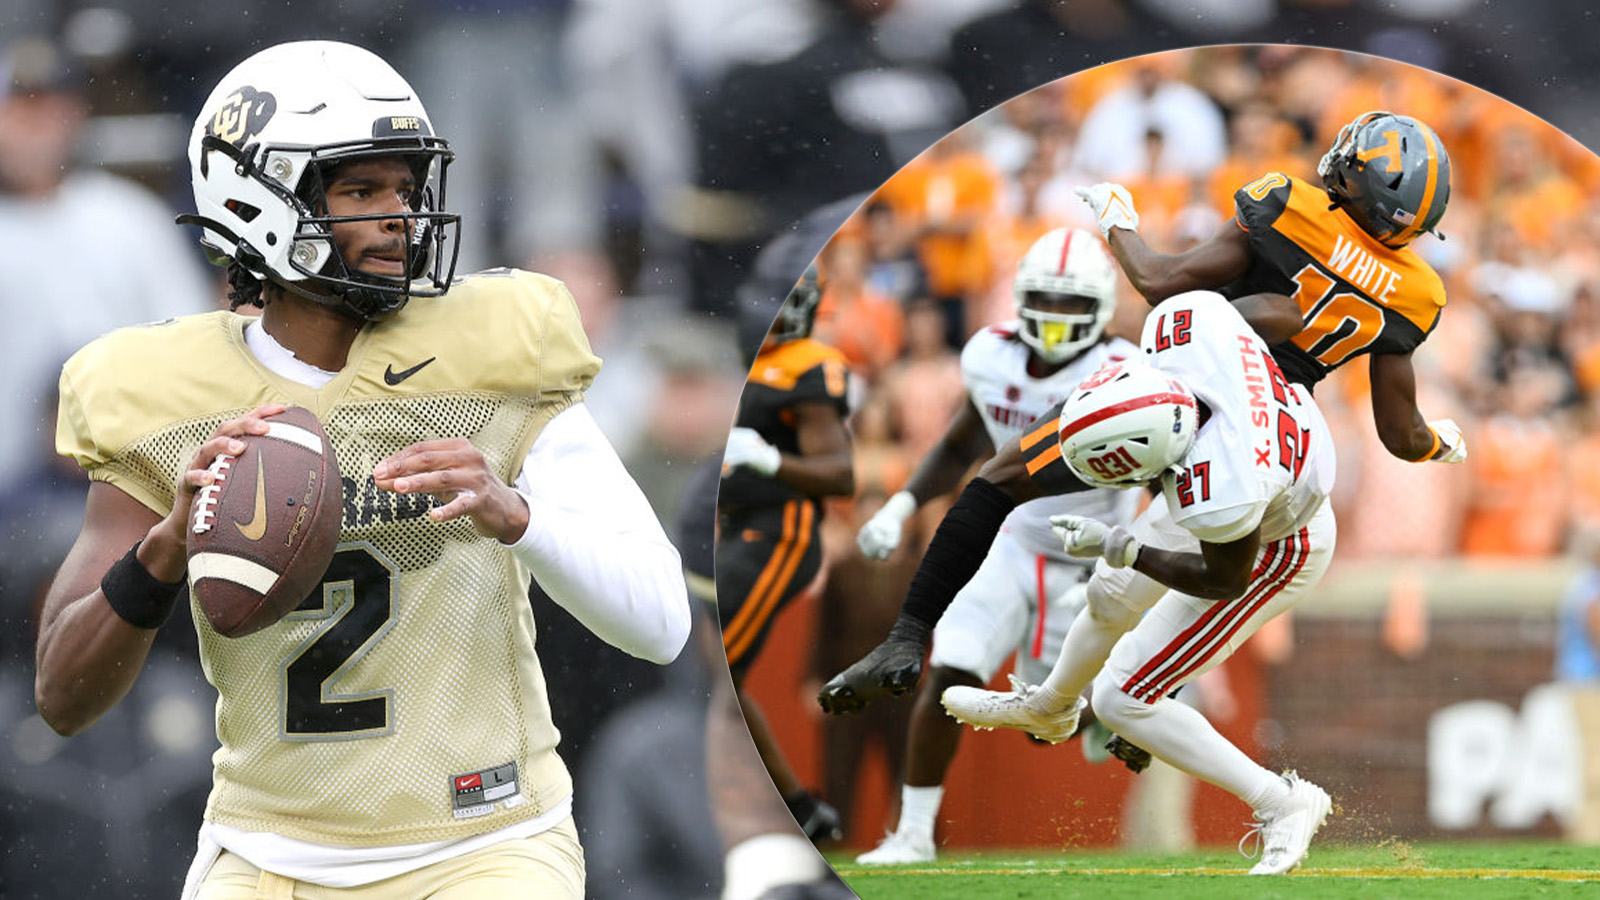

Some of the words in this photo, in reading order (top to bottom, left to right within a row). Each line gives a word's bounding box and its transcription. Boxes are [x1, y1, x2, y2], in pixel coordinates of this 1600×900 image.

[391, 117, 420, 130] BUFFS
[1242, 172, 1288, 201] 10
[1327, 235, 1402, 304] WHITE
[1289, 263, 1386, 367] 10
[1236, 334, 1269, 429] SMITH
[1087, 445, 1142, 480] 931
[1254, 439, 1271, 469] X.
[1176, 460, 1211, 509] 27
[279, 540, 401, 742] 2
[494, 771, 502, 782] L
